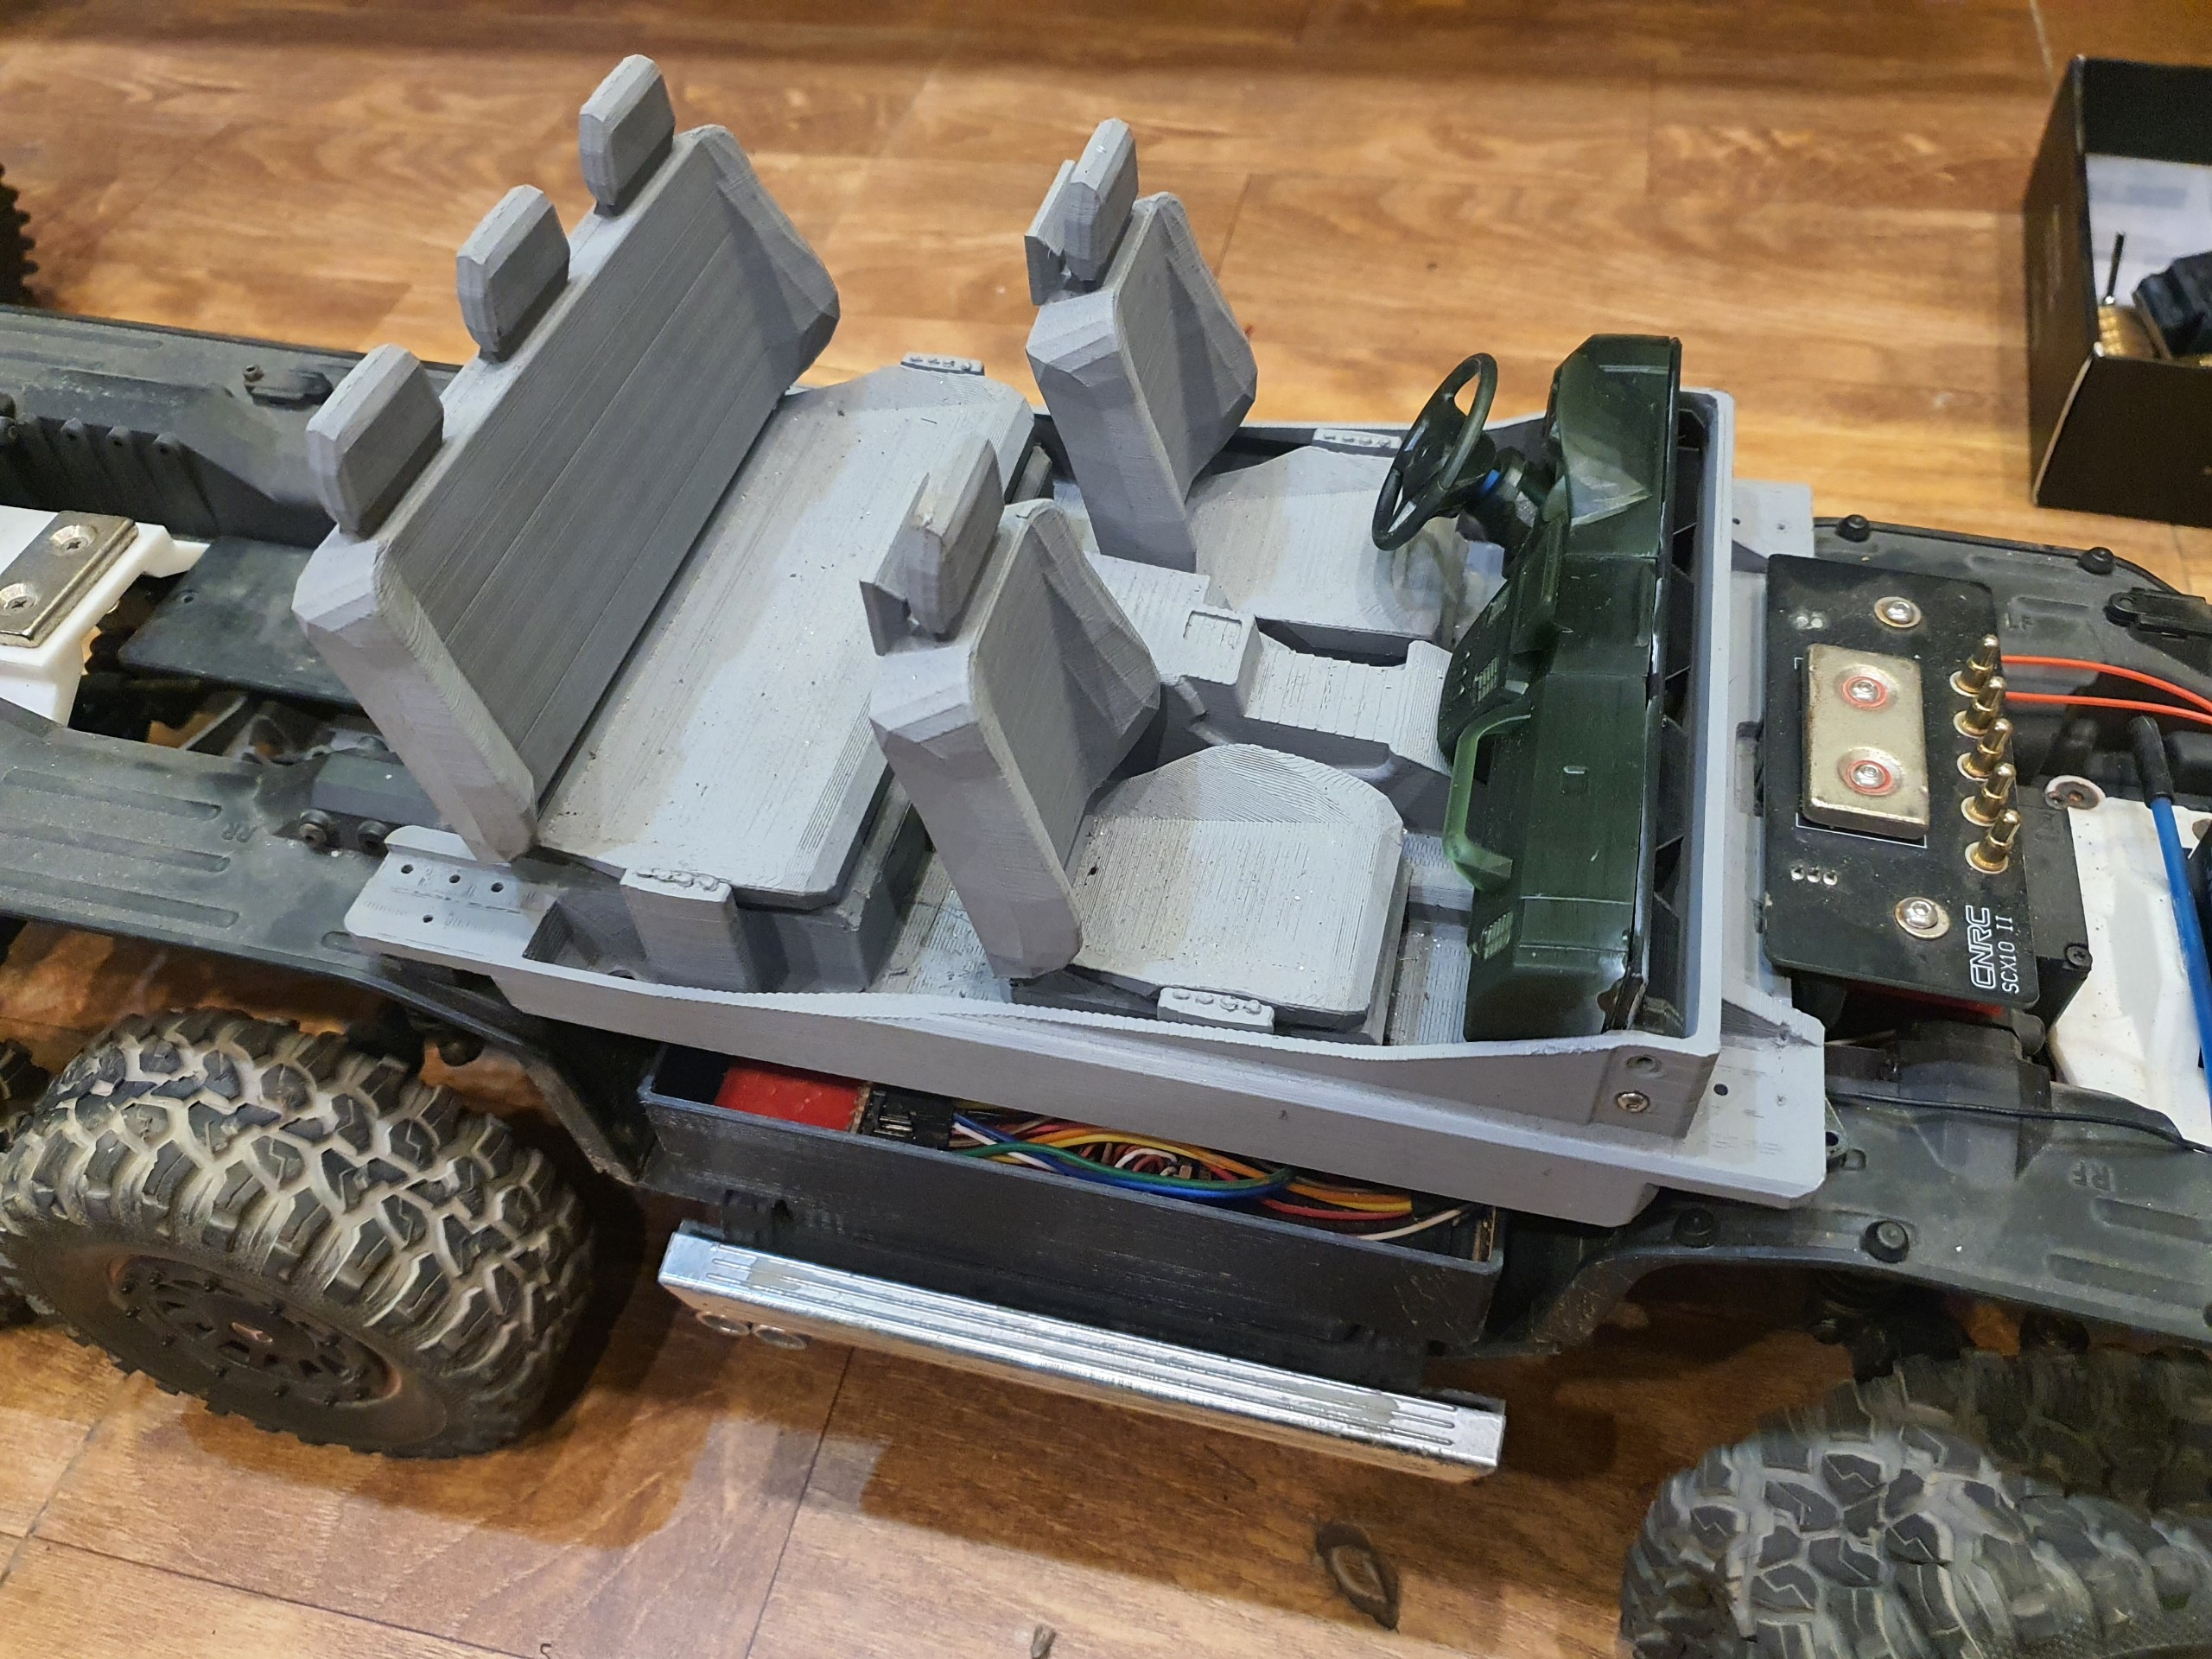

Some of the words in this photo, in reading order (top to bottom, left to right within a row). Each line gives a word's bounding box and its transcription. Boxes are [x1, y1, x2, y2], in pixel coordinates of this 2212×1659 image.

[1965, 905, 1997, 989] CNRC
[1994, 914, 2014, 932] II
[1997, 941, 2019, 995] SCX10
